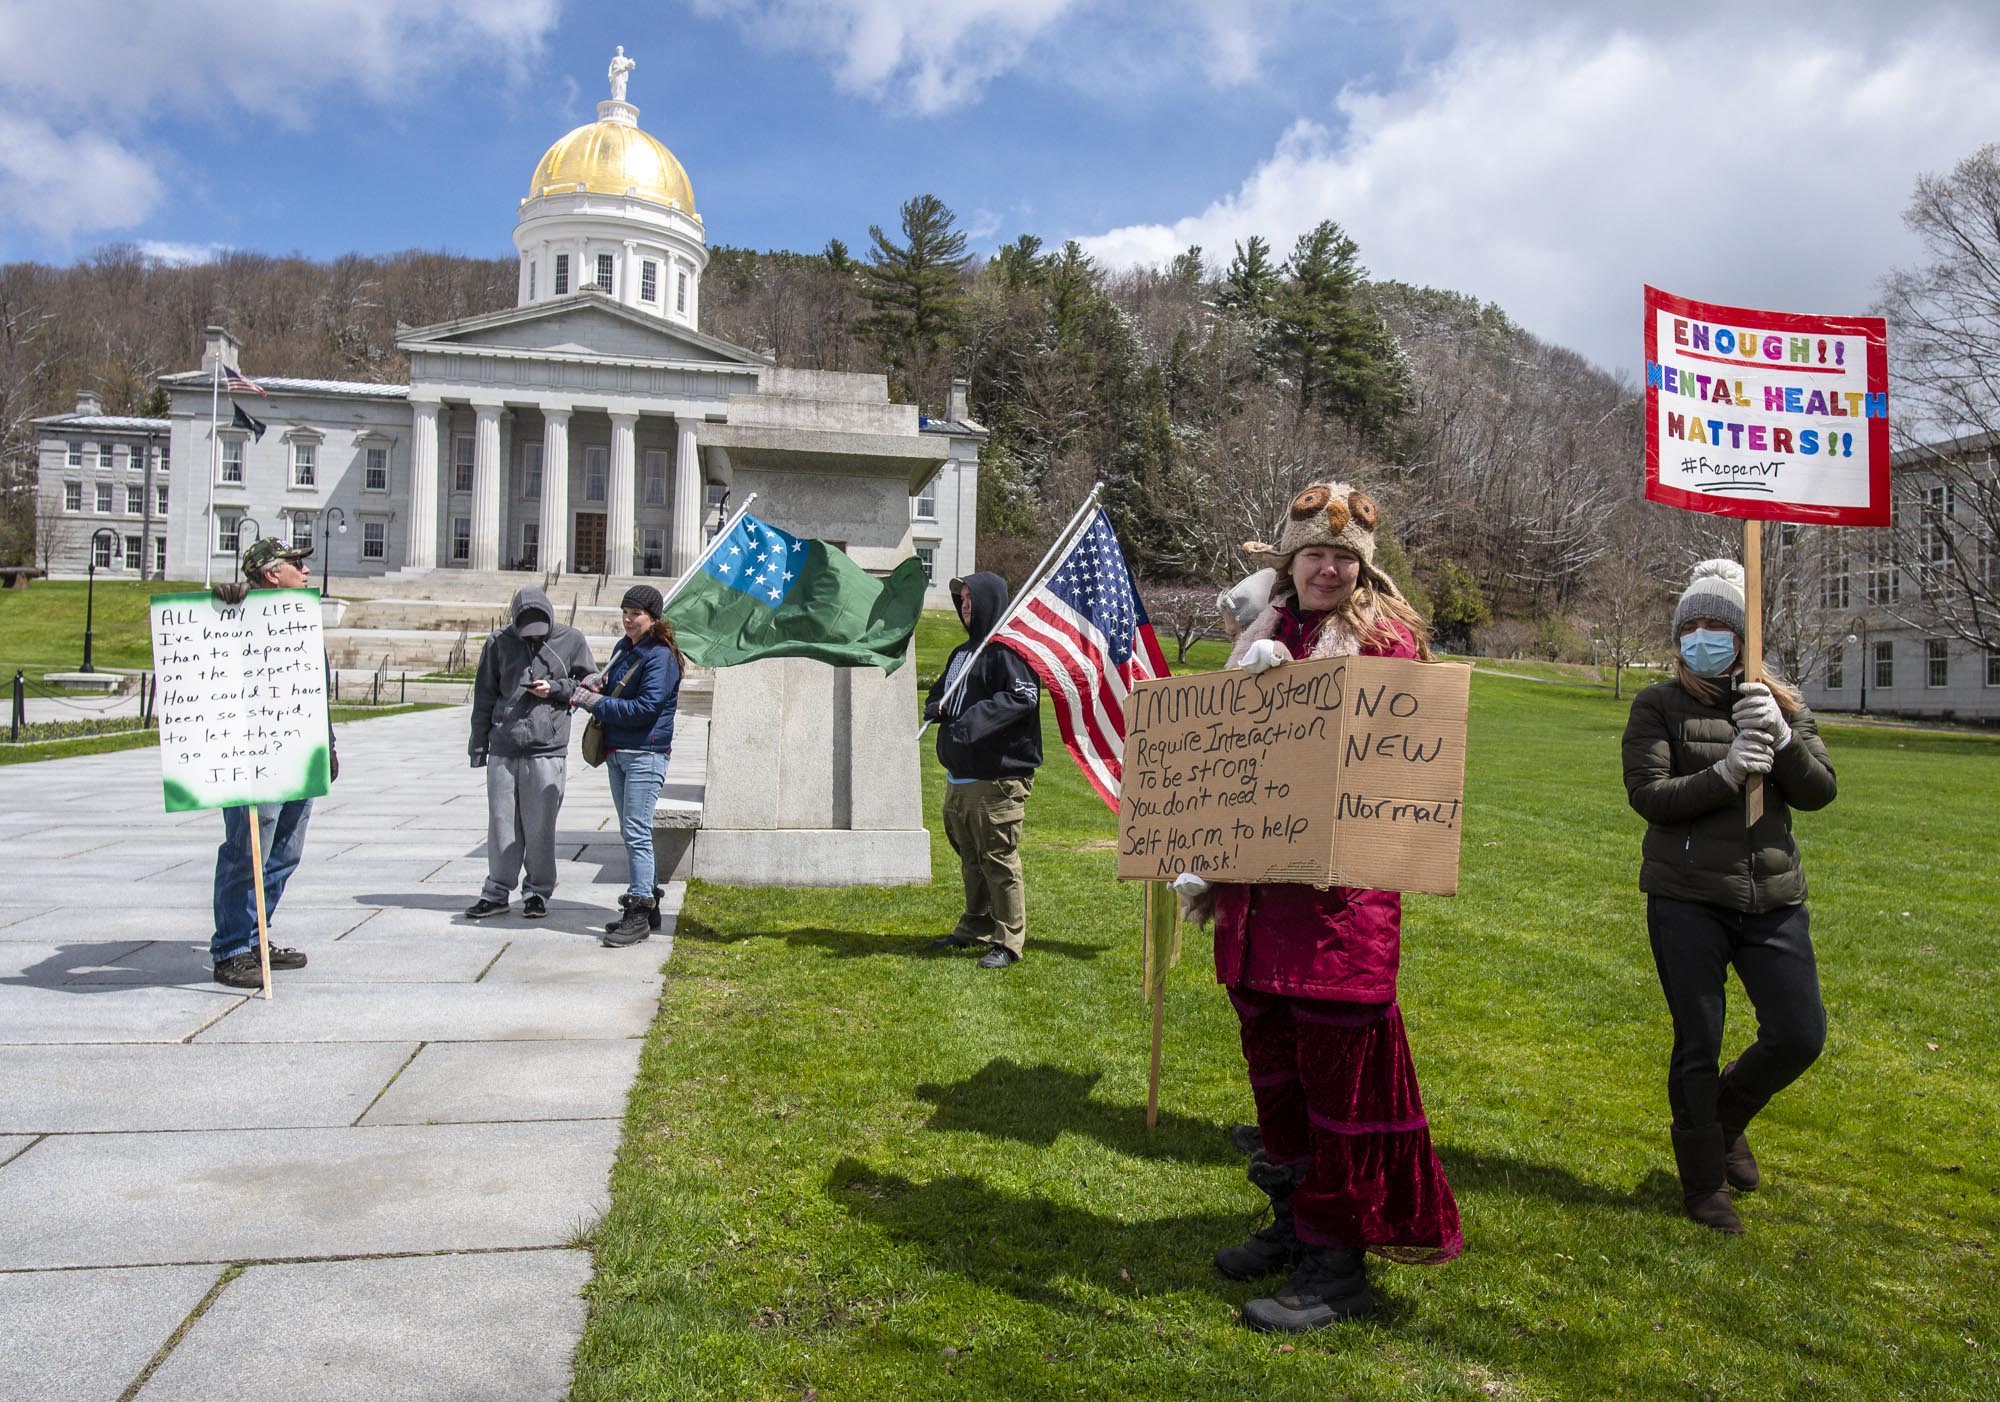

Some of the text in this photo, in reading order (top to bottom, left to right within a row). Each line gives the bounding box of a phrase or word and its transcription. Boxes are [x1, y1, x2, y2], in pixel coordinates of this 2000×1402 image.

[1674, 319, 1844, 365] ENOUGH!!
[1647, 360, 1886, 418] MENTAL HEALTH
[1668, 411, 1852, 458] MATTERS!!
[1681, 457, 1785, 482] #ReopenVT
[162, 603, 306, 626] ALL MY LIFE
[159, 622, 318, 646] I've known better
[160, 641, 306, 665] than to depend
[163, 660, 319, 683] on the experts.
[163, 681, 322, 706] How could I have
[1354, 685, 1419, 718] NO
[165, 704, 311, 725] been so stupid,
[164, 725, 301, 744] to let them
[1137, 716, 1326, 769] Require Interaction
[180, 740, 283, 764] go ahead?
[1345, 732, 1442, 767] NEW
[1139, 750, 1267, 789] To be strong!
[1163, 786, 1212, 816] don't
[1217, 783, 1257, 808] need
[1265, 780, 1290, 799] to
[1123, 825, 1160, 856] Self
[1232, 818, 1254, 842] to
